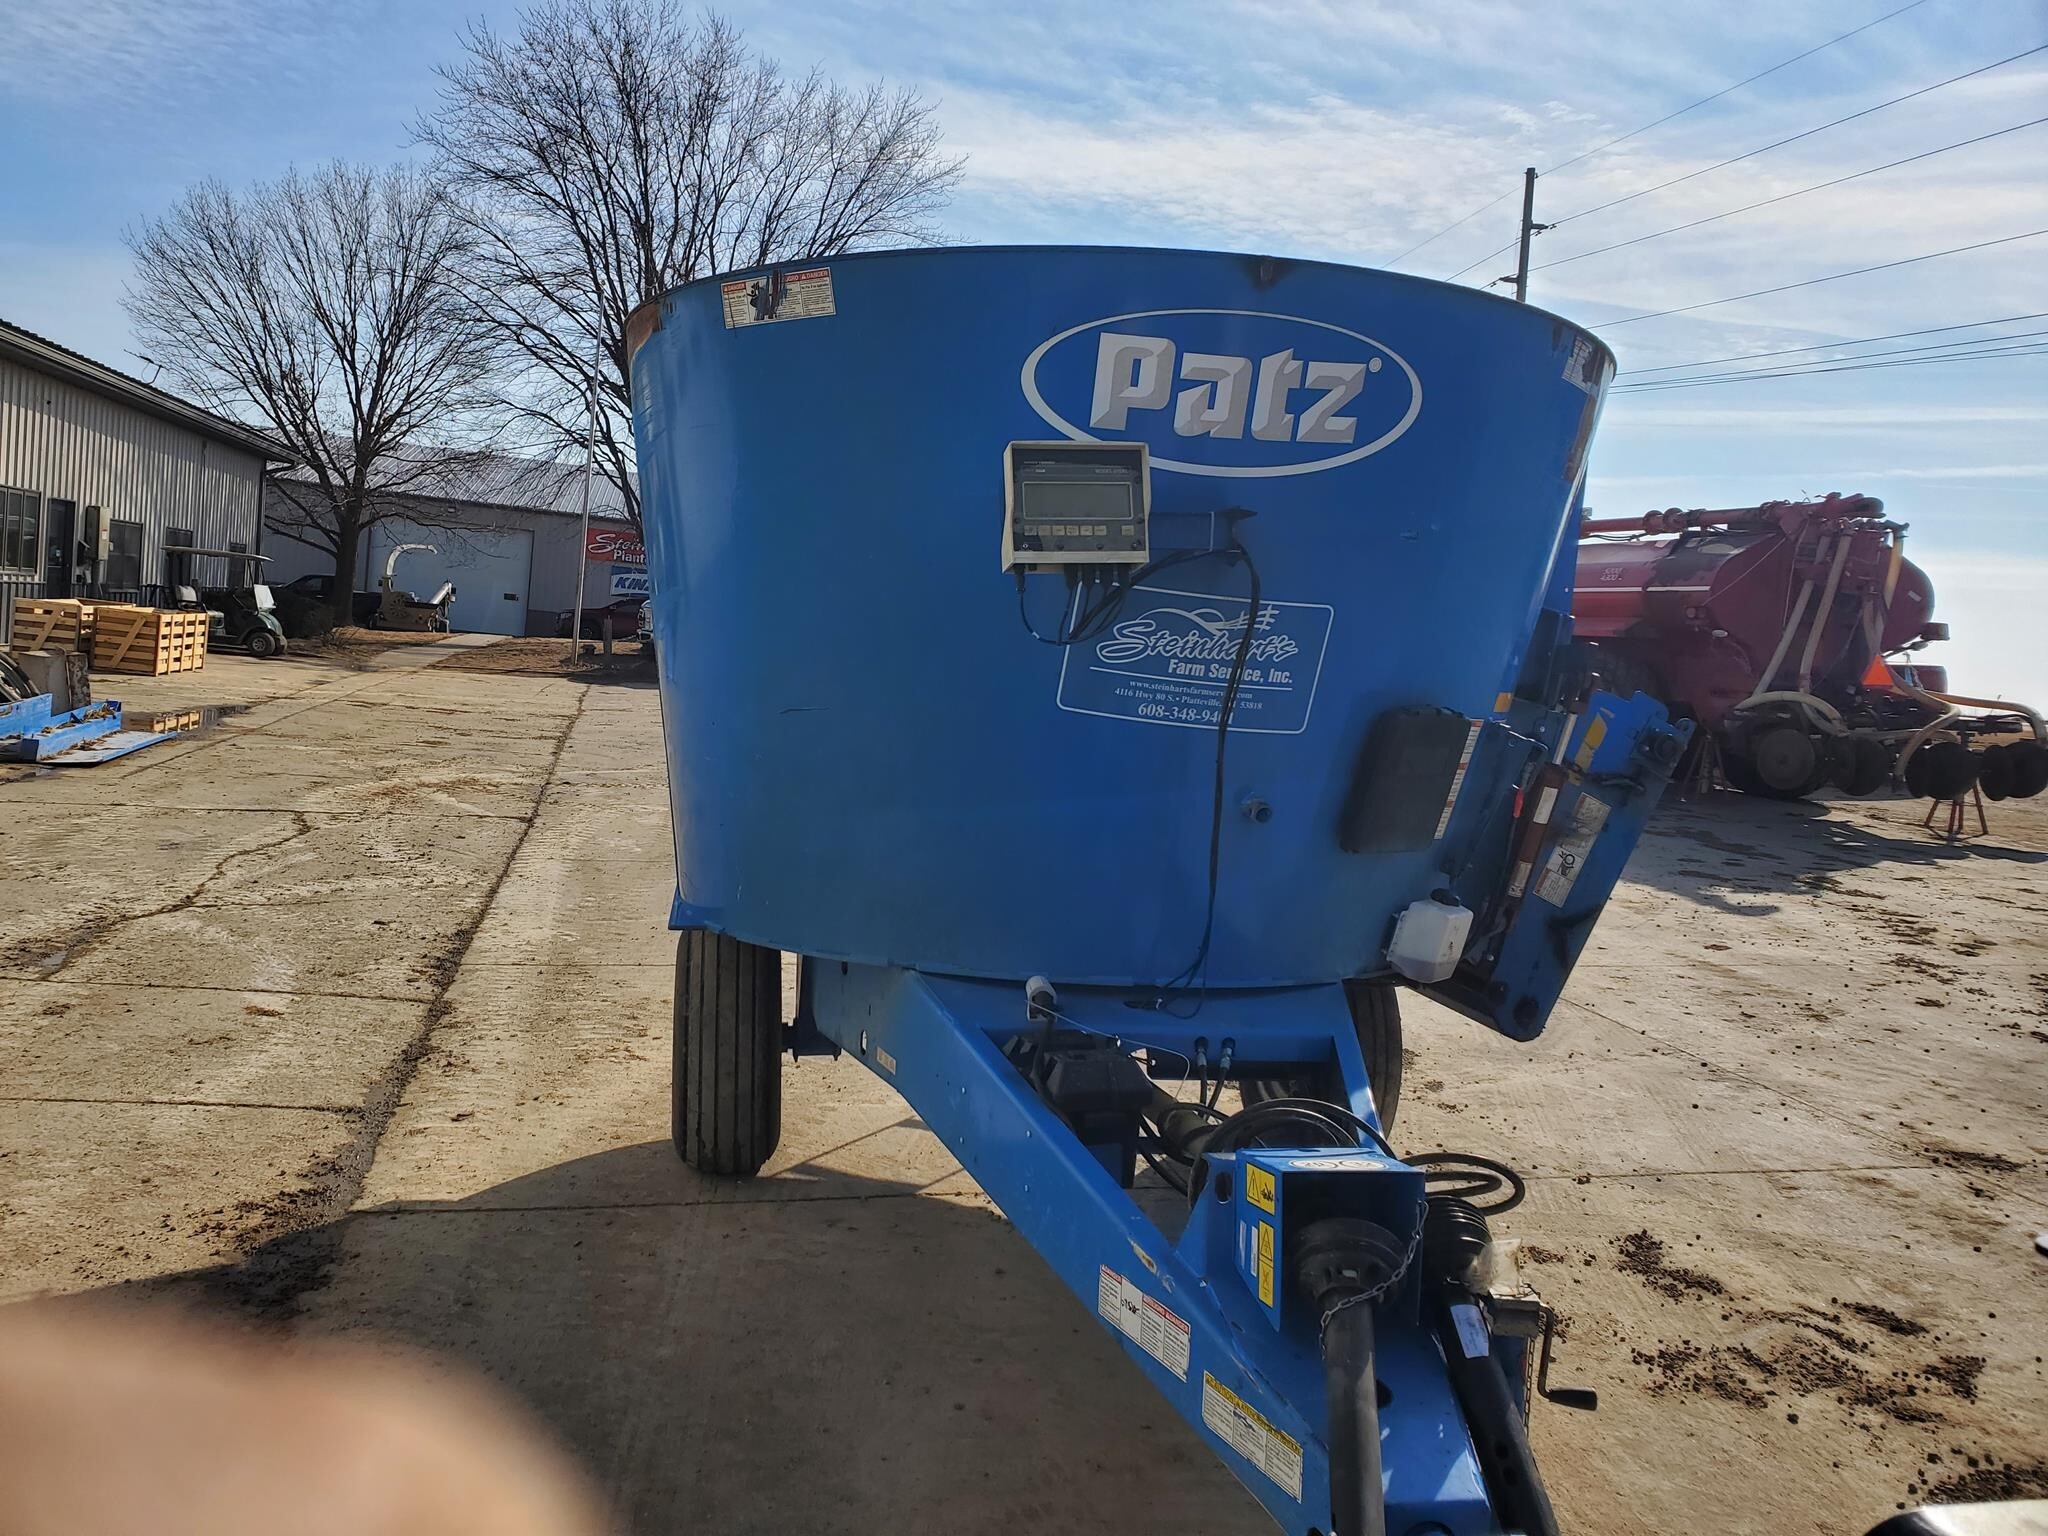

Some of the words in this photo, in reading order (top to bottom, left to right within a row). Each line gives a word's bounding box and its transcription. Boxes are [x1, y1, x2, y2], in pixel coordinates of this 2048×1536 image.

[1089, 331, 1368, 445] Patz
[1168, 658, 1206, 677] Farm
[1268, 667, 1293, 684] Inc.
[1114, 687, 1134, 698] 4116
[1135, 690, 1153, 701] Hwy
[1155, 692, 1166, 702] 80
[1166, 694, 1175, 702] S.
[1240, 700, 1263, 710] 53818
[1138, 702, 1234, 725] 608-348-941
